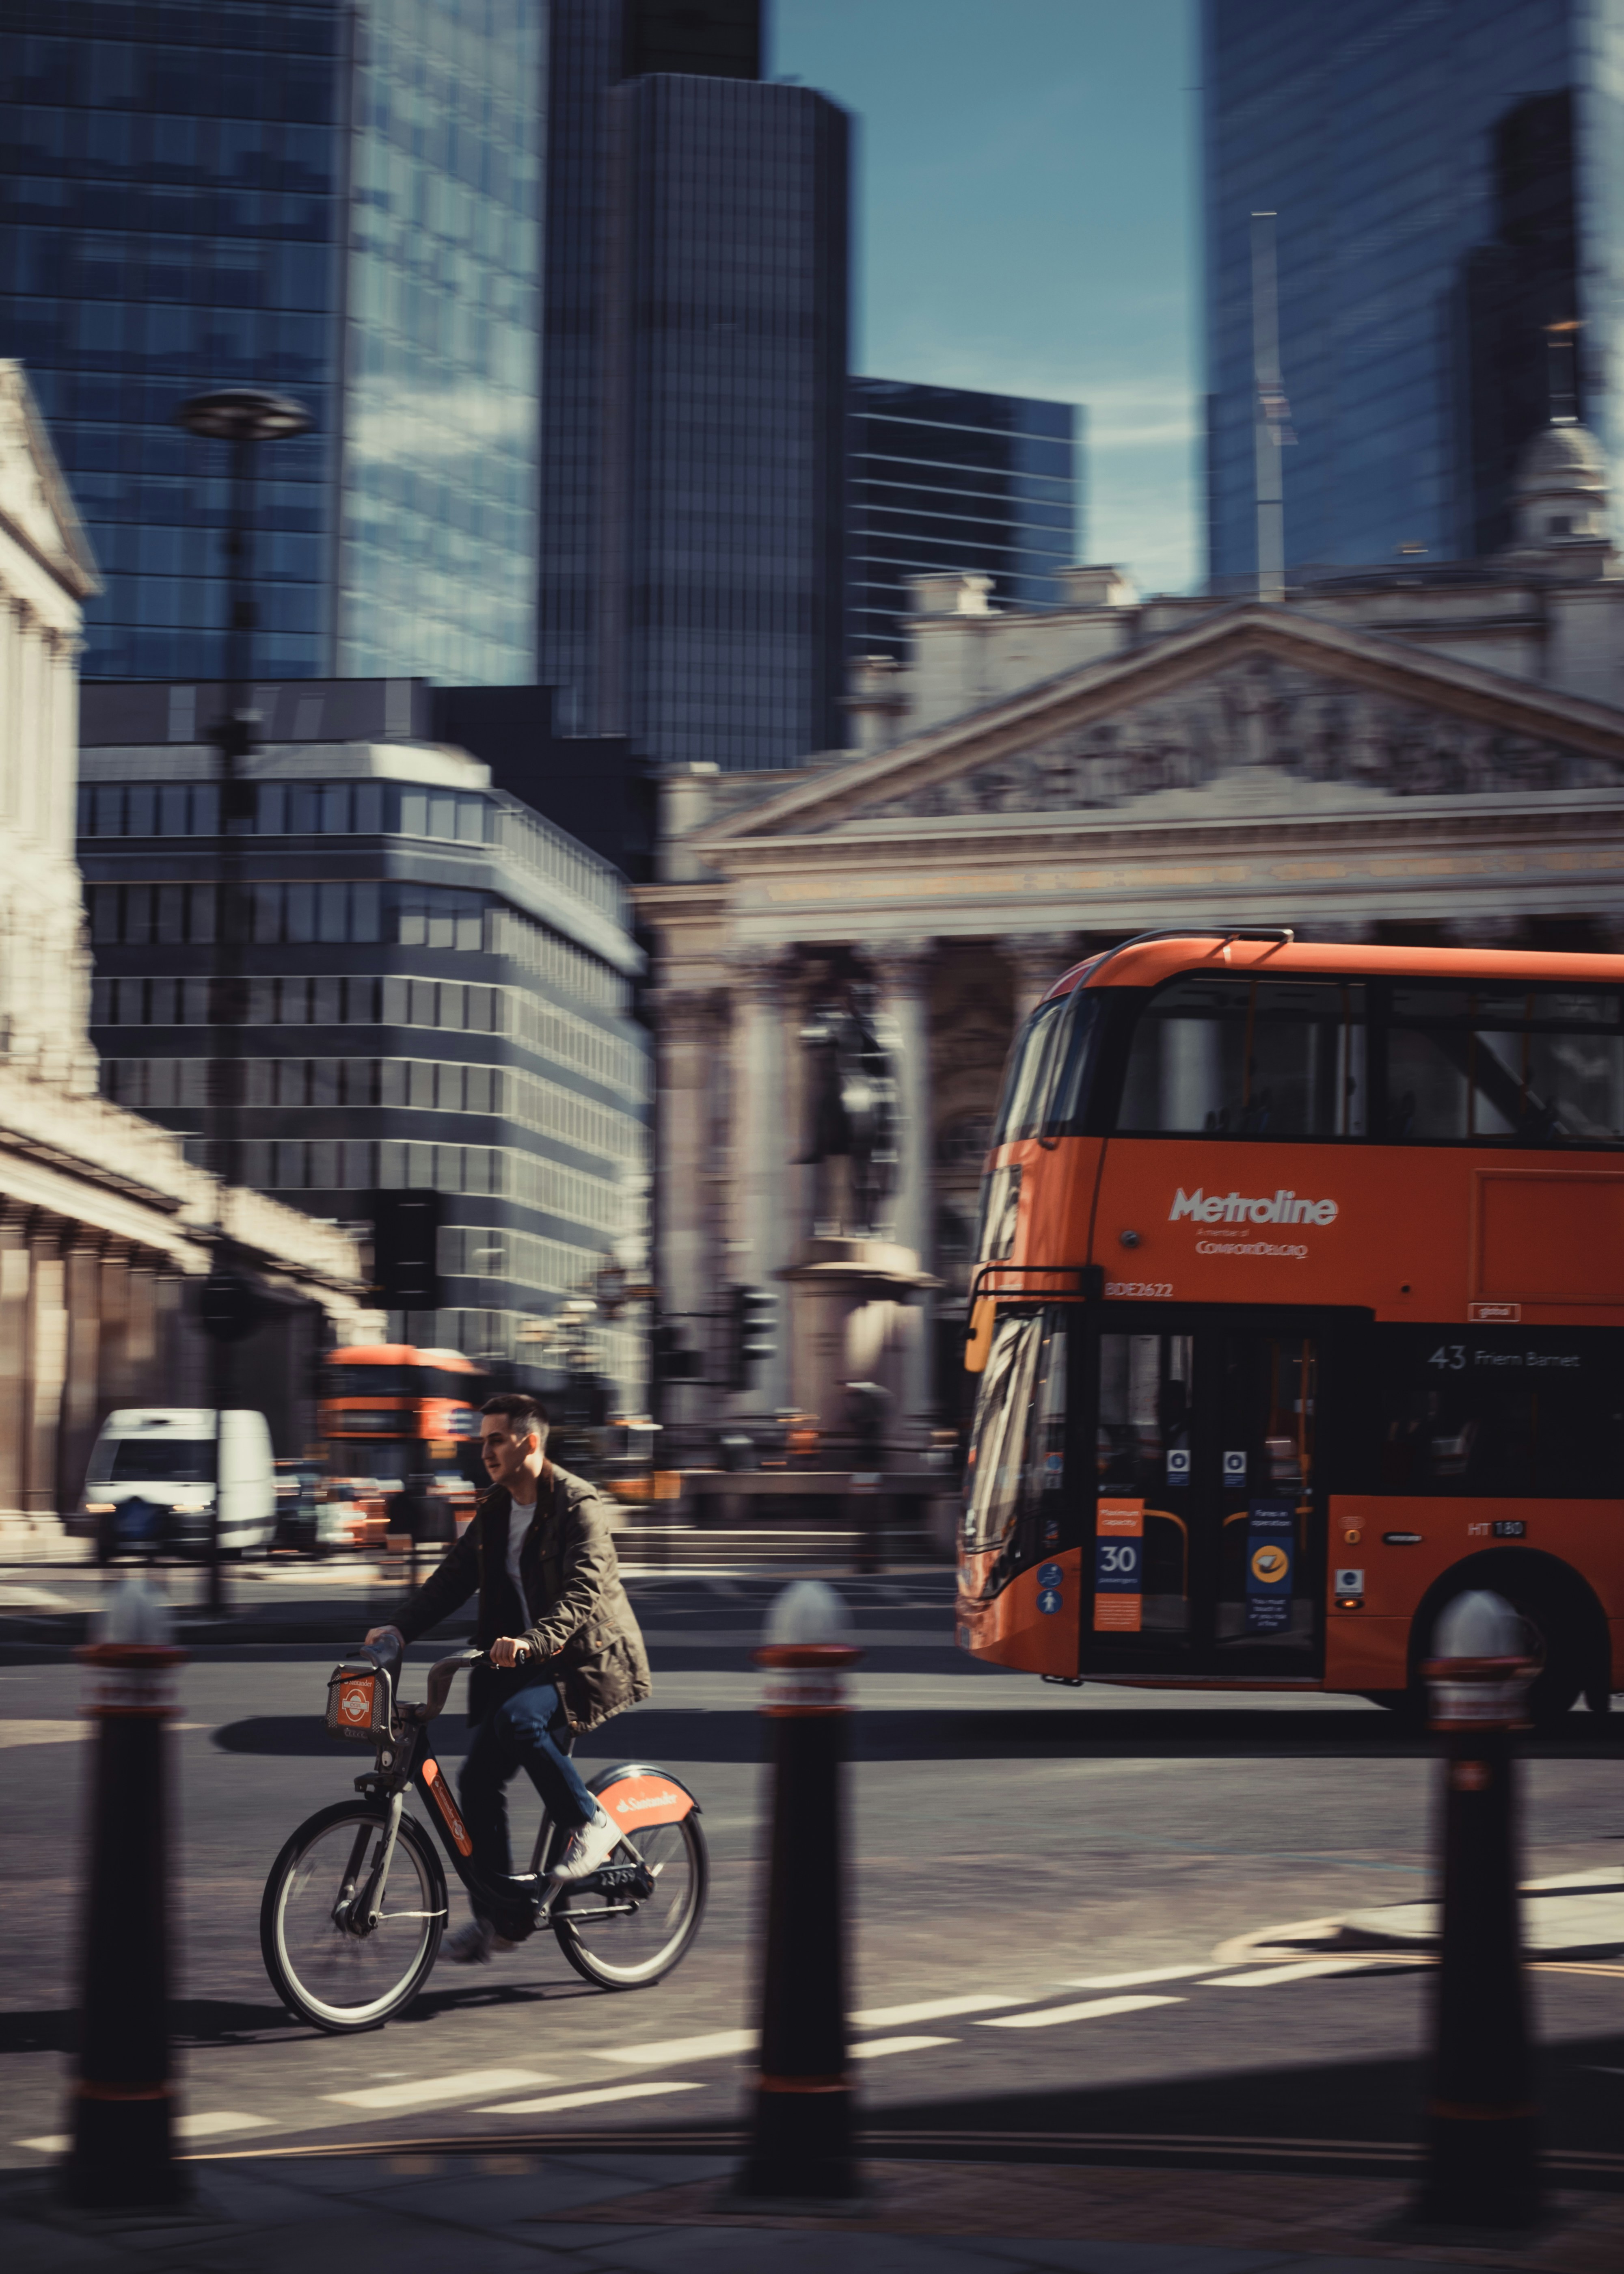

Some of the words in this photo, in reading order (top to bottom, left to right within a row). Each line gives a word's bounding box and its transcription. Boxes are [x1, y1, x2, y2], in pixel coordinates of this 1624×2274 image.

[1168, 1187, 1338, 1225] Metroline
[1105, 1282, 1174, 1297] BDE2622
[1427, 1345, 1466, 1369] 43
[1467, 1523, 1492, 1536] HT
[1495, 1522, 1523, 1535] 180
[1100, 1546, 1136, 1572] 30
[628, 1790, 678, 1811] Santander
